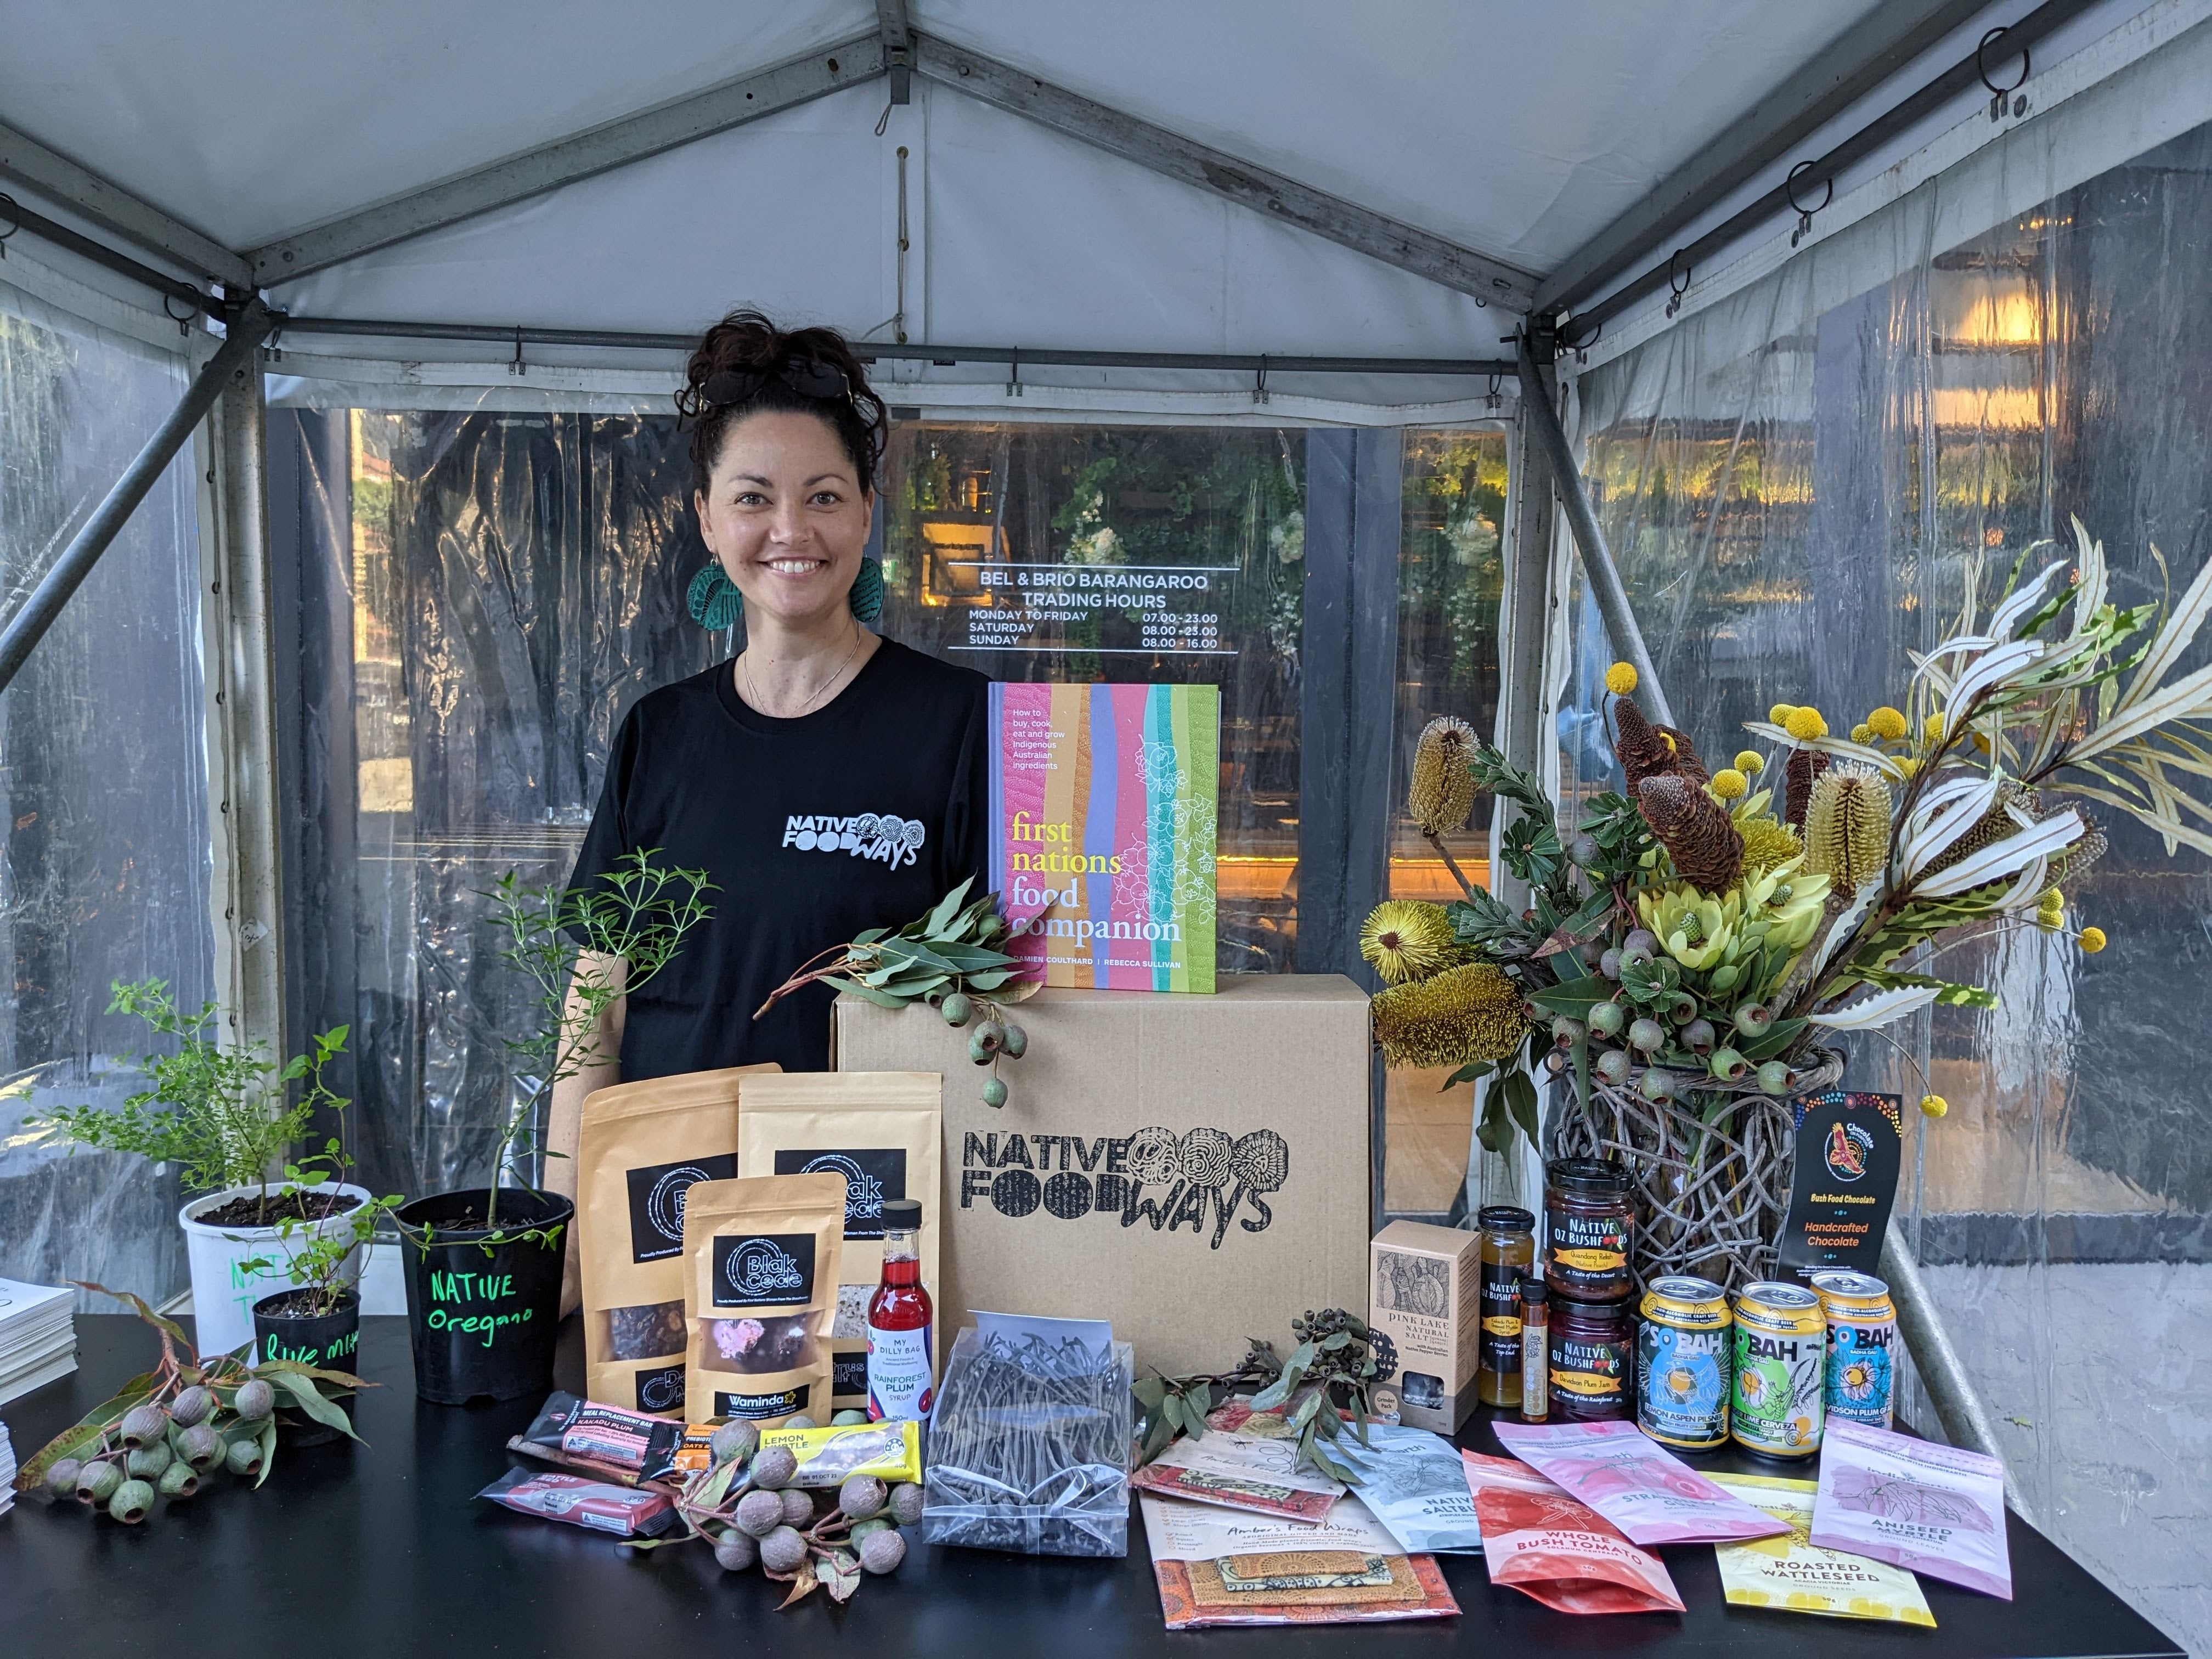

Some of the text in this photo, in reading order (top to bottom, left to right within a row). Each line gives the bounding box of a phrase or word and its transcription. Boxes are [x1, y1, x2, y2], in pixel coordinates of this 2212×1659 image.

[981, 572, 1207, 590] BEL & BRIO BARANGAROO
[1023, 592, 1166, 608] TRADING HOURS
[969, 610, 1217, 624] MONDAY TO FRIDAY 07.00 23.00
[969, 623, 1217, 636] SATURDAY 08.00 23.00
[969, 635, 1217, 648] SUNDAY 08.00 16.00
[1013, 720, 1053, 729] buy, cook,
[1013, 741, 1057, 751] Indigenous
[1013, 761, 1058, 771] ingredients
[786, 815, 857, 833] NATIVE
[1012, 811, 1072, 843] first
[1012, 847, 1122, 874] nations
[1012, 876, 1080, 909] food
[1012, 913, 1182, 949] companion
[1046, 956, 1093, 965] COULTHARD
[1104, 959, 1141, 967] REBECCA
[1847, 1123, 1874, 1148] Chocolate
[963, 1131, 1130, 1173] NATIVE
[1810, 1193, 1876, 1204] Bush Food Chocolate
[1570, 1218, 1615, 1234] NATIVE
[1804, 1222, 1869, 1233] Handcrafted
[1555, 1228, 1566, 1242] OZ
[1808, 1236, 1859, 1246] Chocolate
[1571, 1251, 1597, 1262] Quandong
[748, 1254, 797, 1274] Blak
[431, 1271, 516, 1304] NATIVE
[1490, 1282, 1519, 1293] NATIVE
[428, 1308, 532, 1347] Oregano
[1389, 1313, 1449, 1330] PINK LAKE
[1405, 1332, 1429, 1341] SALT
[1406, 1325, 1449, 1338] NATURAL
[1827, 1324, 1893, 1349] SOBAH
[1650, 1325, 1723, 1355] SOBAH
[905, 1346, 921, 1354] BAG
[1553, 1350, 1562, 1362] OZ
[1565, 1342, 1605, 1358] NATIVE
[874, 1372, 926, 1383] RAINFOREST
[1560, 1374, 1582, 1386] Davidson
[886, 1383, 914, 1392] PLUM
[729, 1395, 784, 1407] Waminda
[1574, 1394, 1580, 1402] of
[598, 1411, 640, 1425] REPLACEMENT
[1646, 1403, 1723, 1422] LEMON ASPEN PILSNER
[610, 1423, 633, 1432] PLUM
[1745, 1414, 1796, 1430] LIME CERVEZA
[765, 1434, 804, 1445] LEMON
[1872, 1448, 1967, 1477] AUSTRALIA WITH INDIGIEARTH
[1954, 1466, 1988, 1477] FLAVOURS
[1227, 1520, 1369, 1536] Amber's Food Wraps
[1871, 1519, 1953, 1536] ANISEED
[1546, 1531, 1611, 1544] WHOLE
[1877, 1527, 1948, 1543] MYRTLE
[1878, 1534, 1945, 1553] GROUND LEAVES
[1517, 1539, 1643, 1565] BUSH TOMATO
[1774, 1561, 1861, 1572] ROASTED
[1760, 1570, 1880, 1582] WATTLESEED
